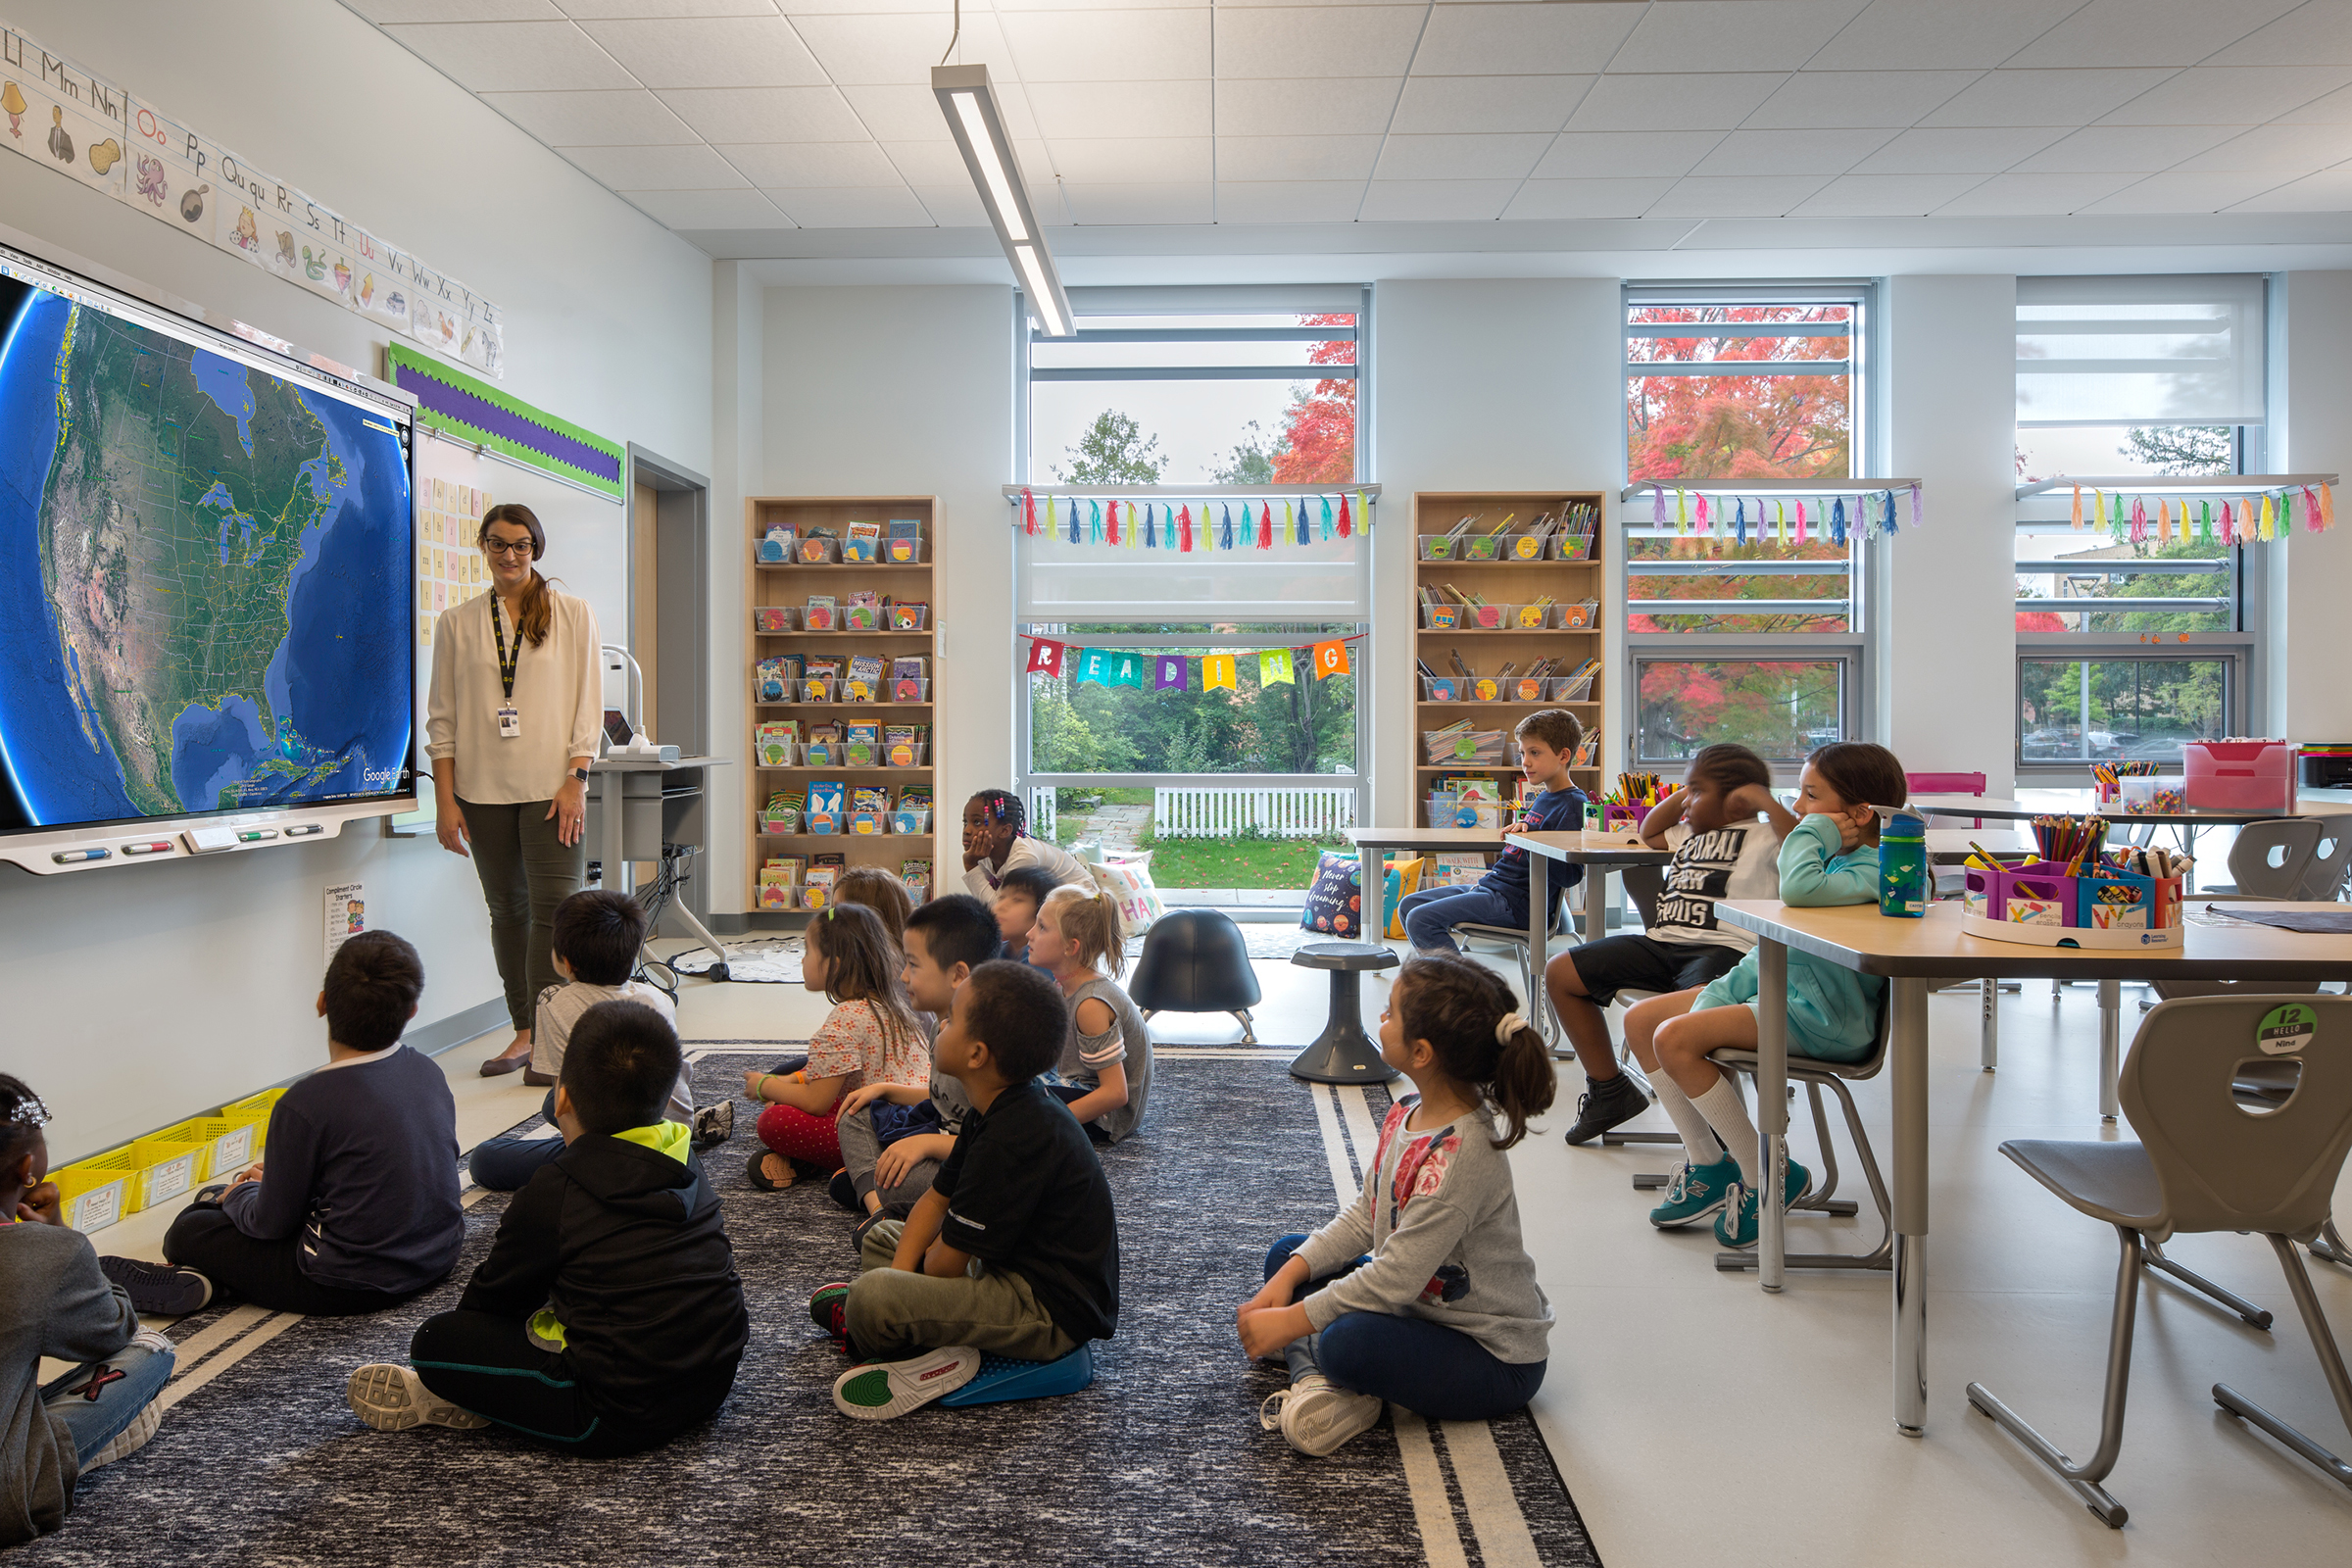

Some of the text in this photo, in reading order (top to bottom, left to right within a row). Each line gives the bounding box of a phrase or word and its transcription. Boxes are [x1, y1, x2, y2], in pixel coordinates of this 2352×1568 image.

[42, 52, 78, 99] Mm
[91, 79, 118, 120] Nn
[137, 109, 167, 145] Oo
[186, 132, 206, 177] Pp
[277, 185, 293, 214] Rr
[307, 203, 319, 230] Ss
[331, 216, 346, 244] Tt
[360, 232, 374, 260] Uu
[387, 247, 403, 274] Vv
[412, 260, 430, 290] Ww
[436, 275, 452, 302] Xx
[462, 288, 475, 320] Yy
[483, 301, 494, 324] Zz
[422, 557, 429, 565] m
[853, 660, 881, 668] MISSION
[857, 666, 880, 675] ARCTIC
[364, 767, 411, 784] Google Earth
[1121, 868, 1152, 891] BE
[1322, 869, 1345, 881] Never
[326, 885, 350, 895] Compliment
[1323, 881, 1340, 895] stop
[335, 893, 353, 902] Starters
[1308, 890, 1346, 911] dreaming
[1119, 895, 1163, 922] HAPP
[2117, 920, 2144, 929] crayons
[2278, 1007, 2302, 1024] 12
[2274, 1024, 2300, 1035] HELLO
